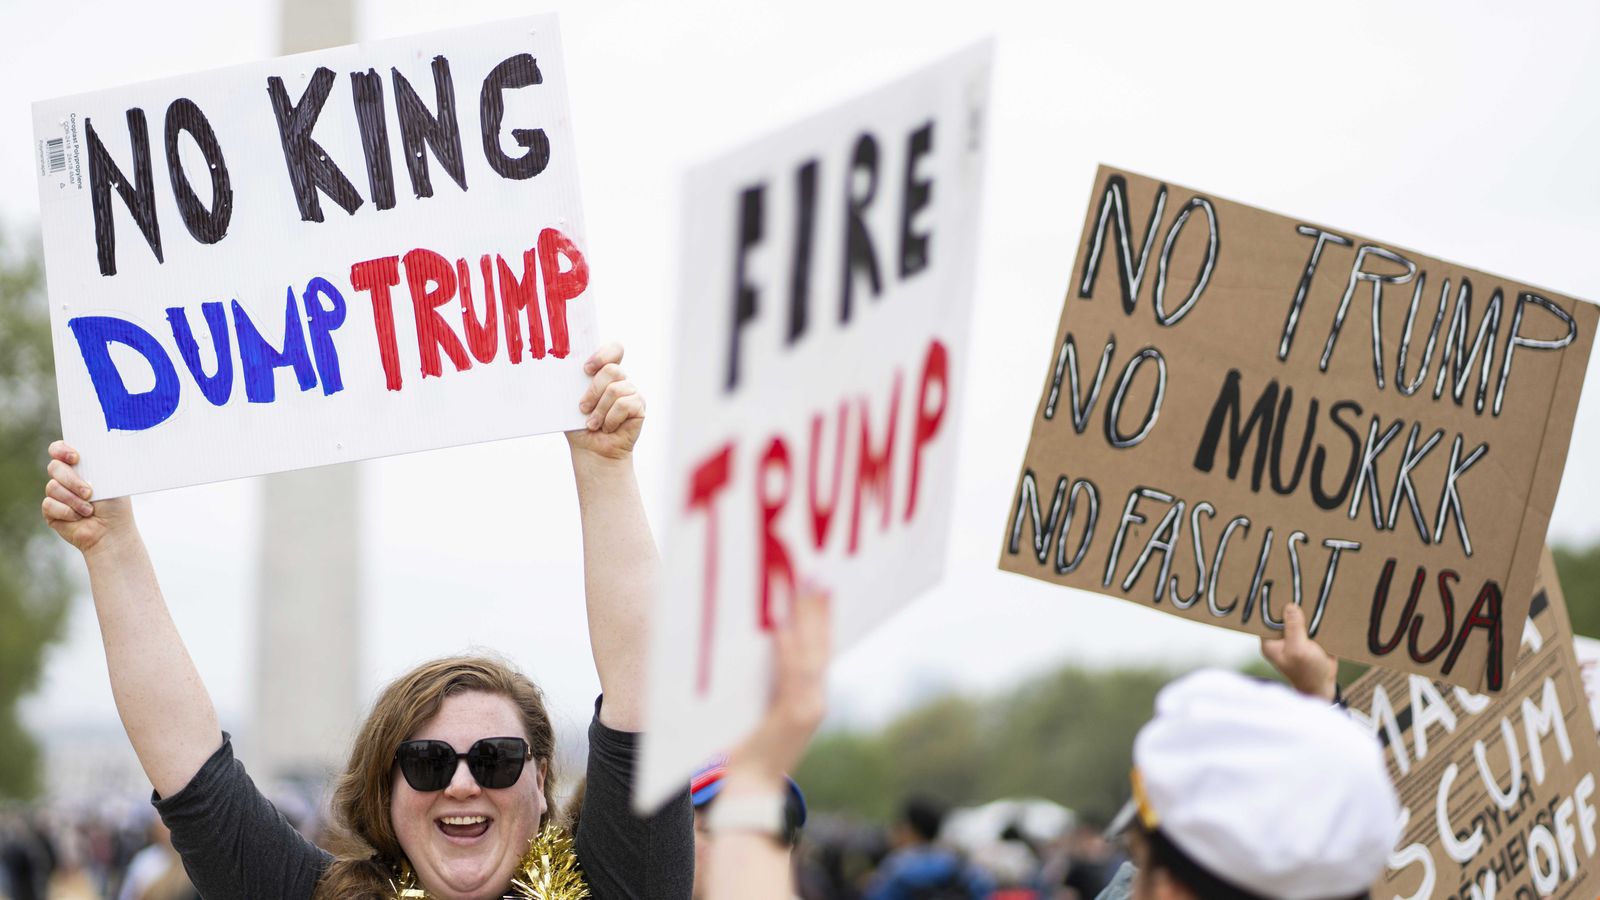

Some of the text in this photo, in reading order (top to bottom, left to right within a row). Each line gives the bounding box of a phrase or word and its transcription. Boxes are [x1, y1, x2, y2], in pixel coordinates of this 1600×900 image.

[70, 113, 82, 190] Coroplast Polypropylene
[85, 53, 550, 276] NO KING
[724, 118, 936, 395] FIRE
[67, 227, 590, 431] DUMP TRUMP
[1079, 173, 1577, 417] NO TRUMP
[684, 338, 950, 697] TRUMP
[1043, 332, 1490, 557] NO MUSKKK
[1008, 468, 1503, 692] NO FASCIST USA
[1527, 770, 1597, 897] OFF
